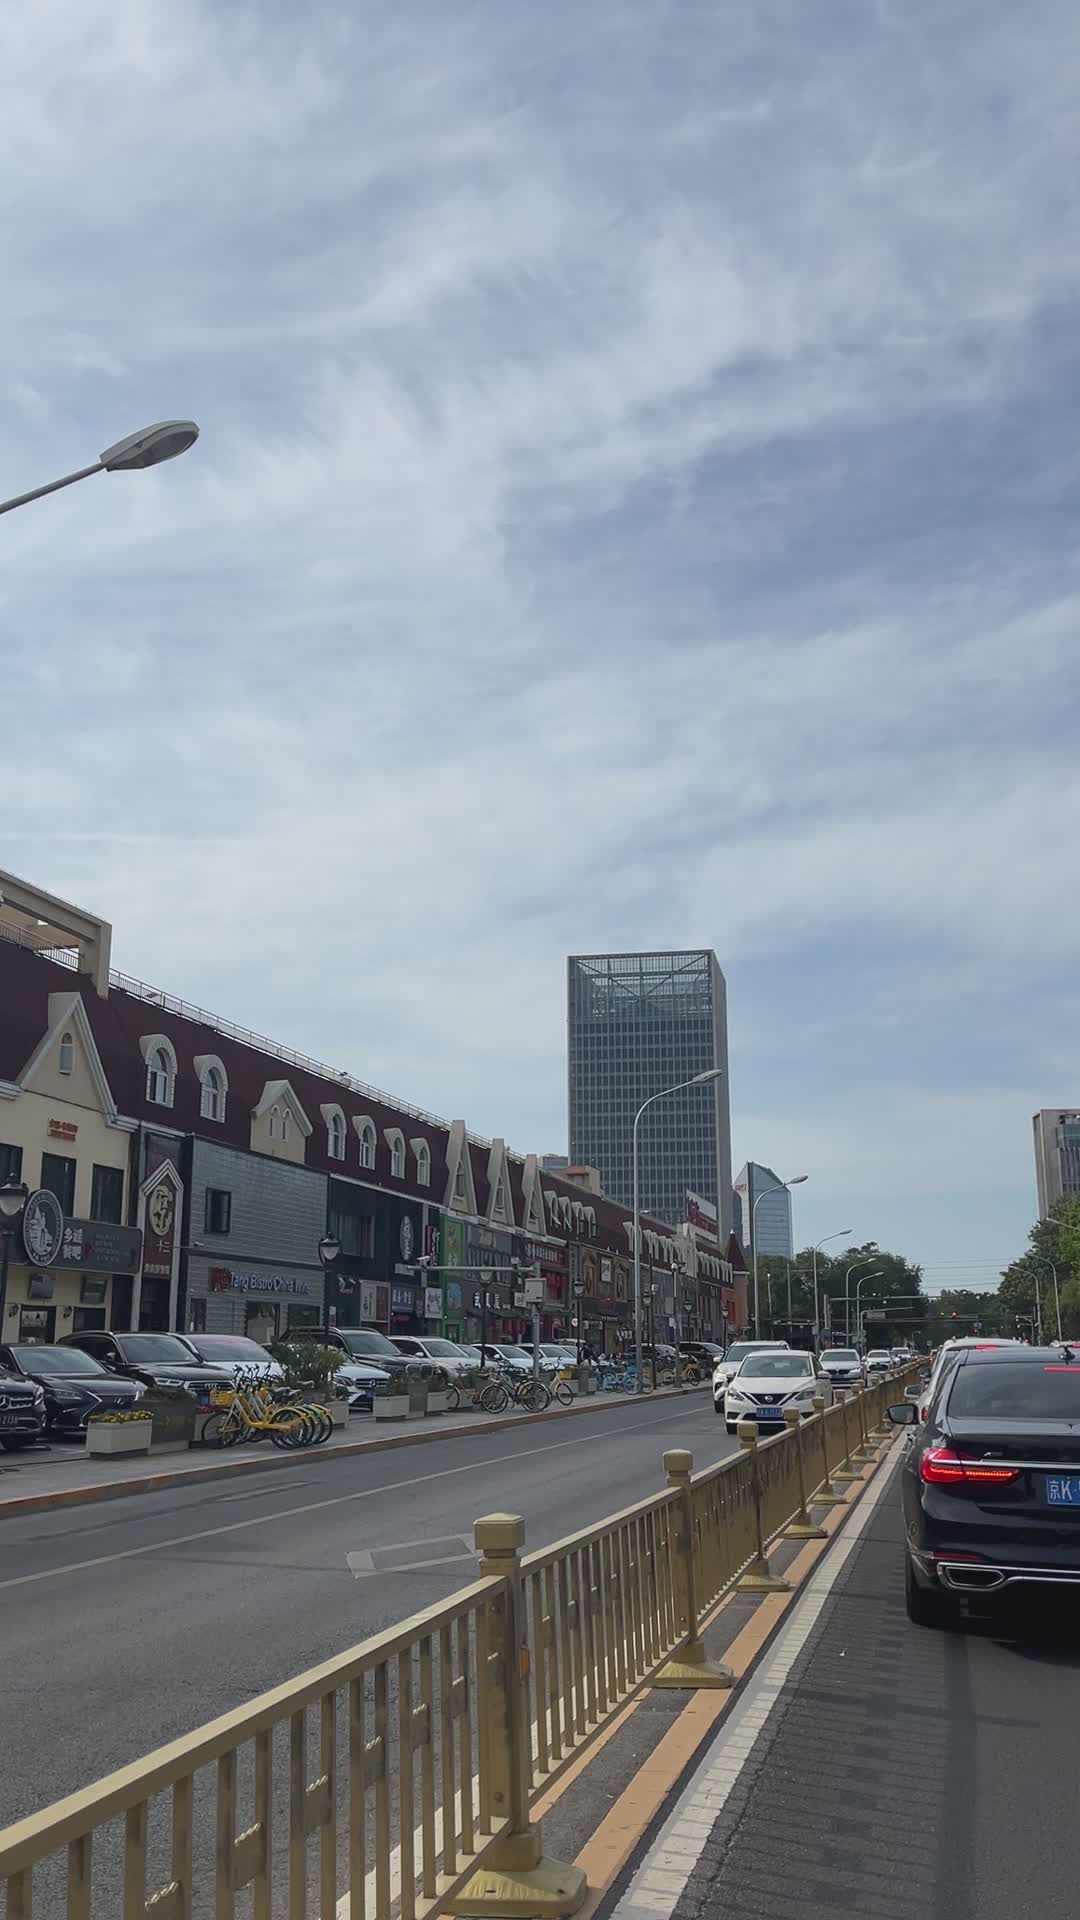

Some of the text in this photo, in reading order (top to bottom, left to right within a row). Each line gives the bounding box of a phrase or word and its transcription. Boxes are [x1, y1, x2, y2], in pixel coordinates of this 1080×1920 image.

[230, 1271, 249, 1292] Tang
[250, 1274, 273, 1290] Bistro
[273, 1276, 294, 1292] China
